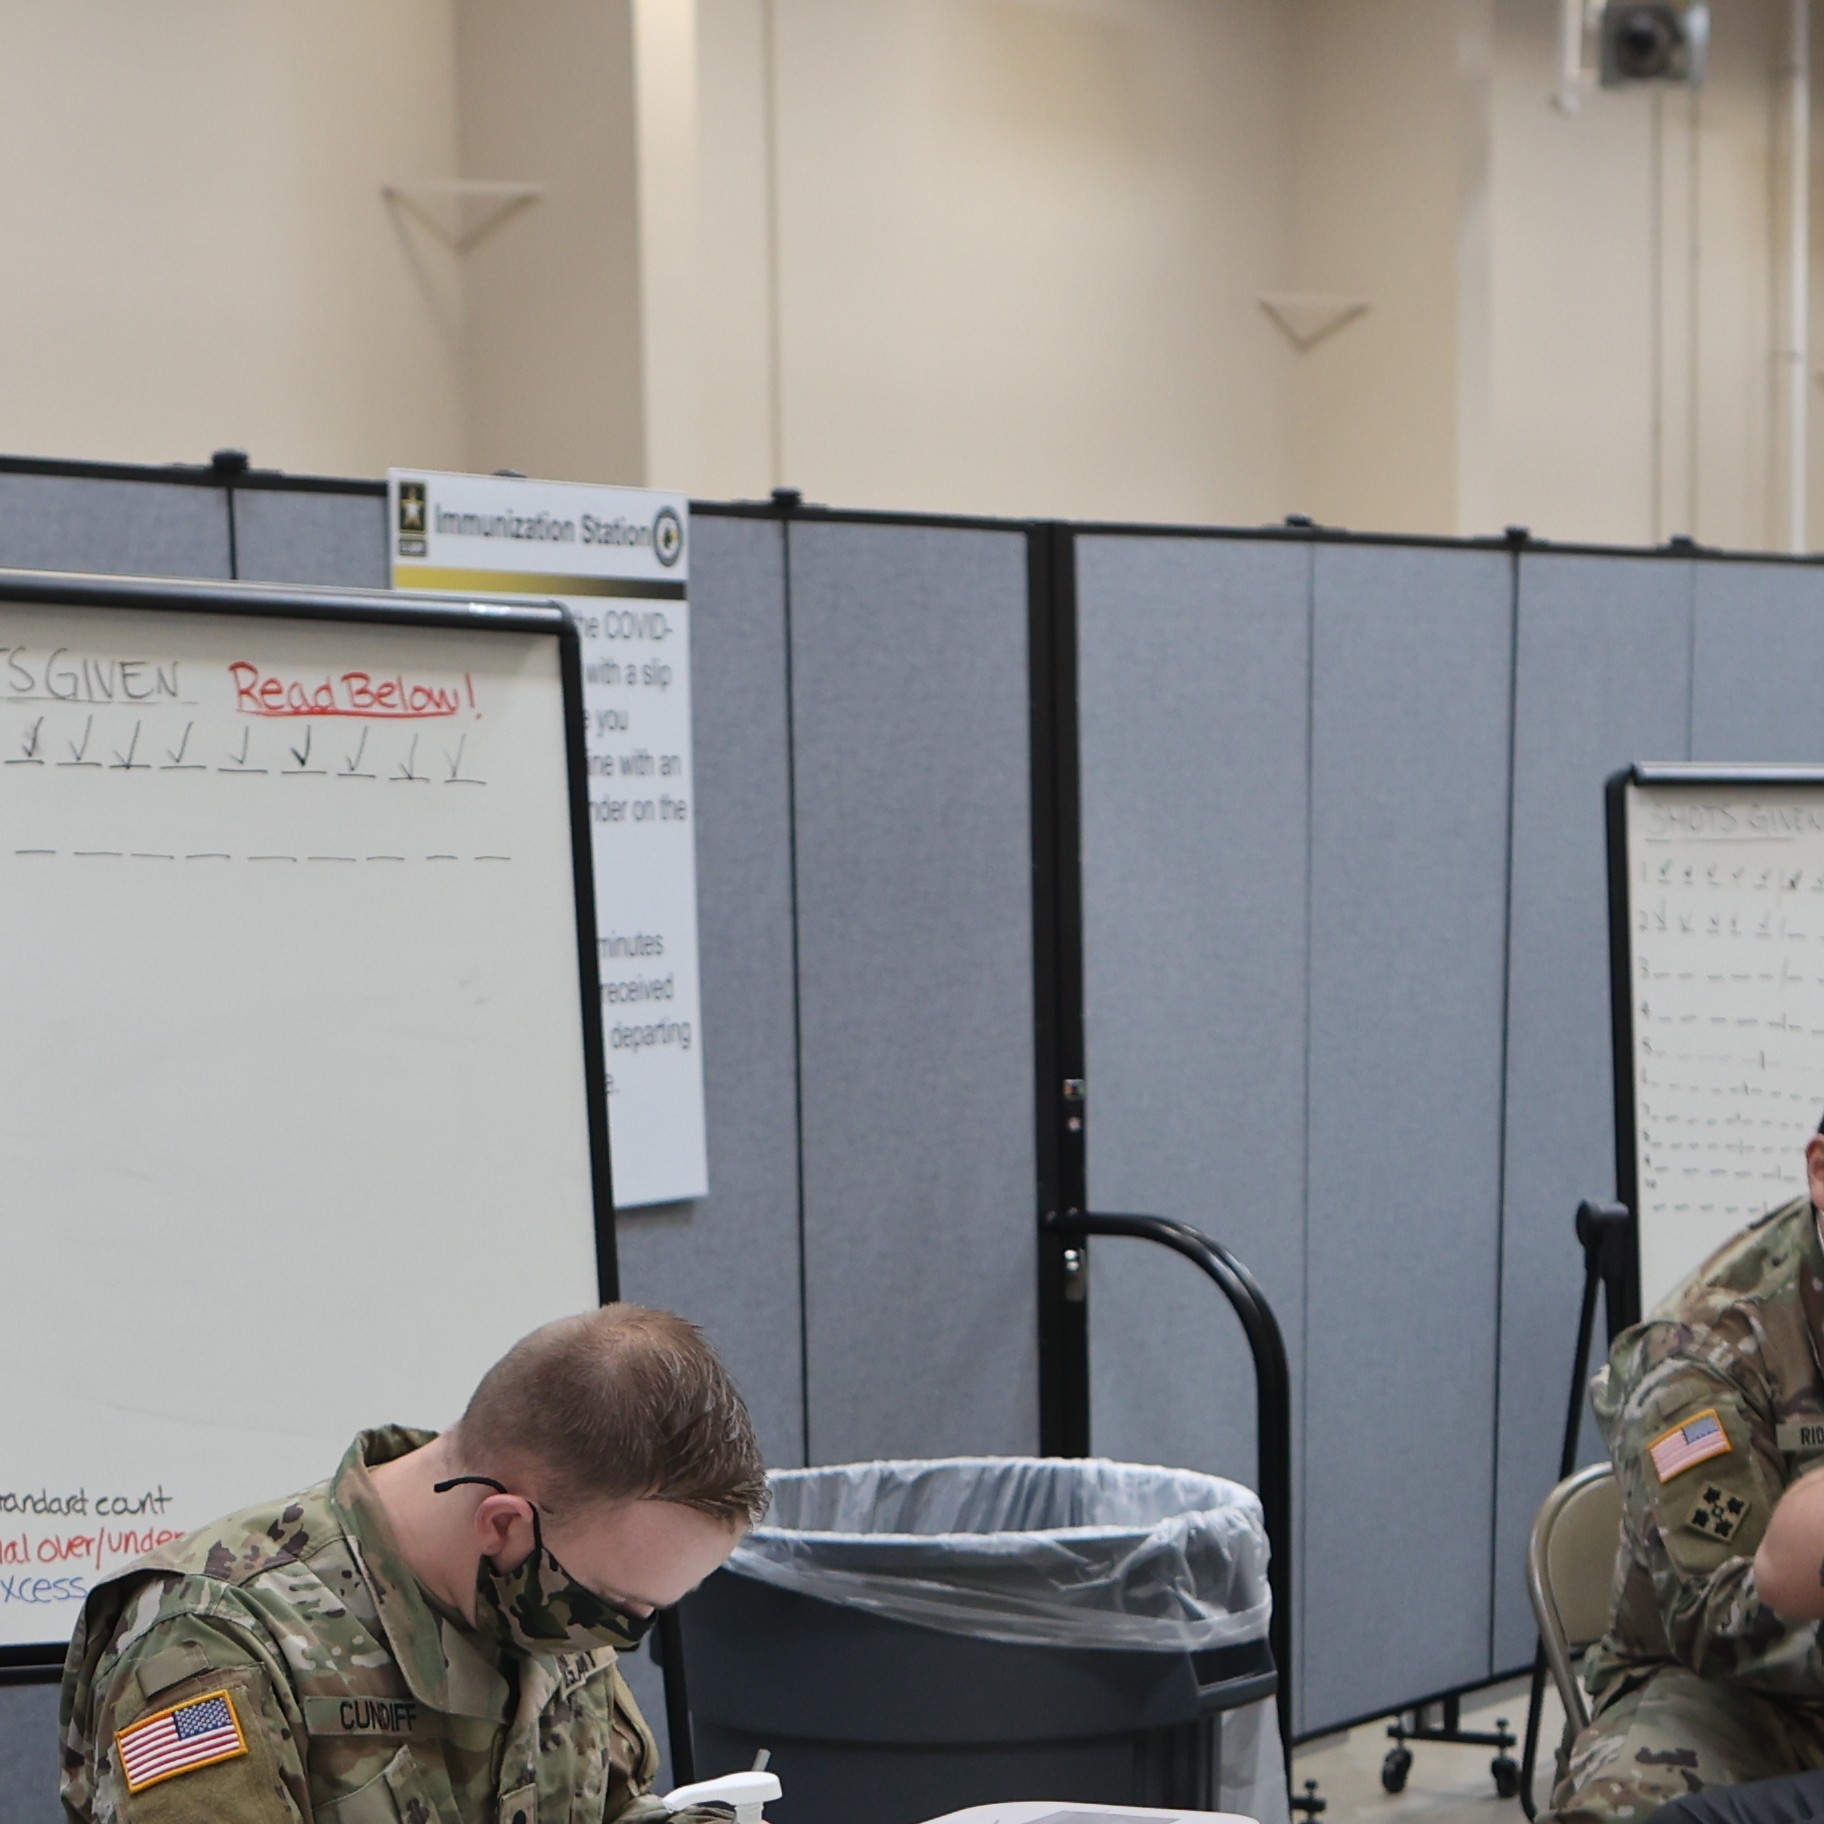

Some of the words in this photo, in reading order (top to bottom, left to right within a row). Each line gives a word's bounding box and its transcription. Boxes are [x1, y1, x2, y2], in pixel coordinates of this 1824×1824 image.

[435, 503, 574, 542] Immunization
[581, 514, 653, 547] Station
[604, 610, 673, 640] COVID-
[45, 648, 179, 699] GIVEN
[228, 660, 338, 711] Read
[627, 664, 637, 685] a
[643, 658, 673, 692] slip
[596, 709, 629, 737] you
[660, 754, 681, 776] an
[633, 800, 656, 822] on
[661, 794, 687, 821] the
[596, 931, 664, 959] minutes
[600, 973, 674, 1003] received
[611, 1017, 691, 1052] departing
[95, 1485, 173, 1517] count
[339, 1700, 417, 1732] CUNDIFF
